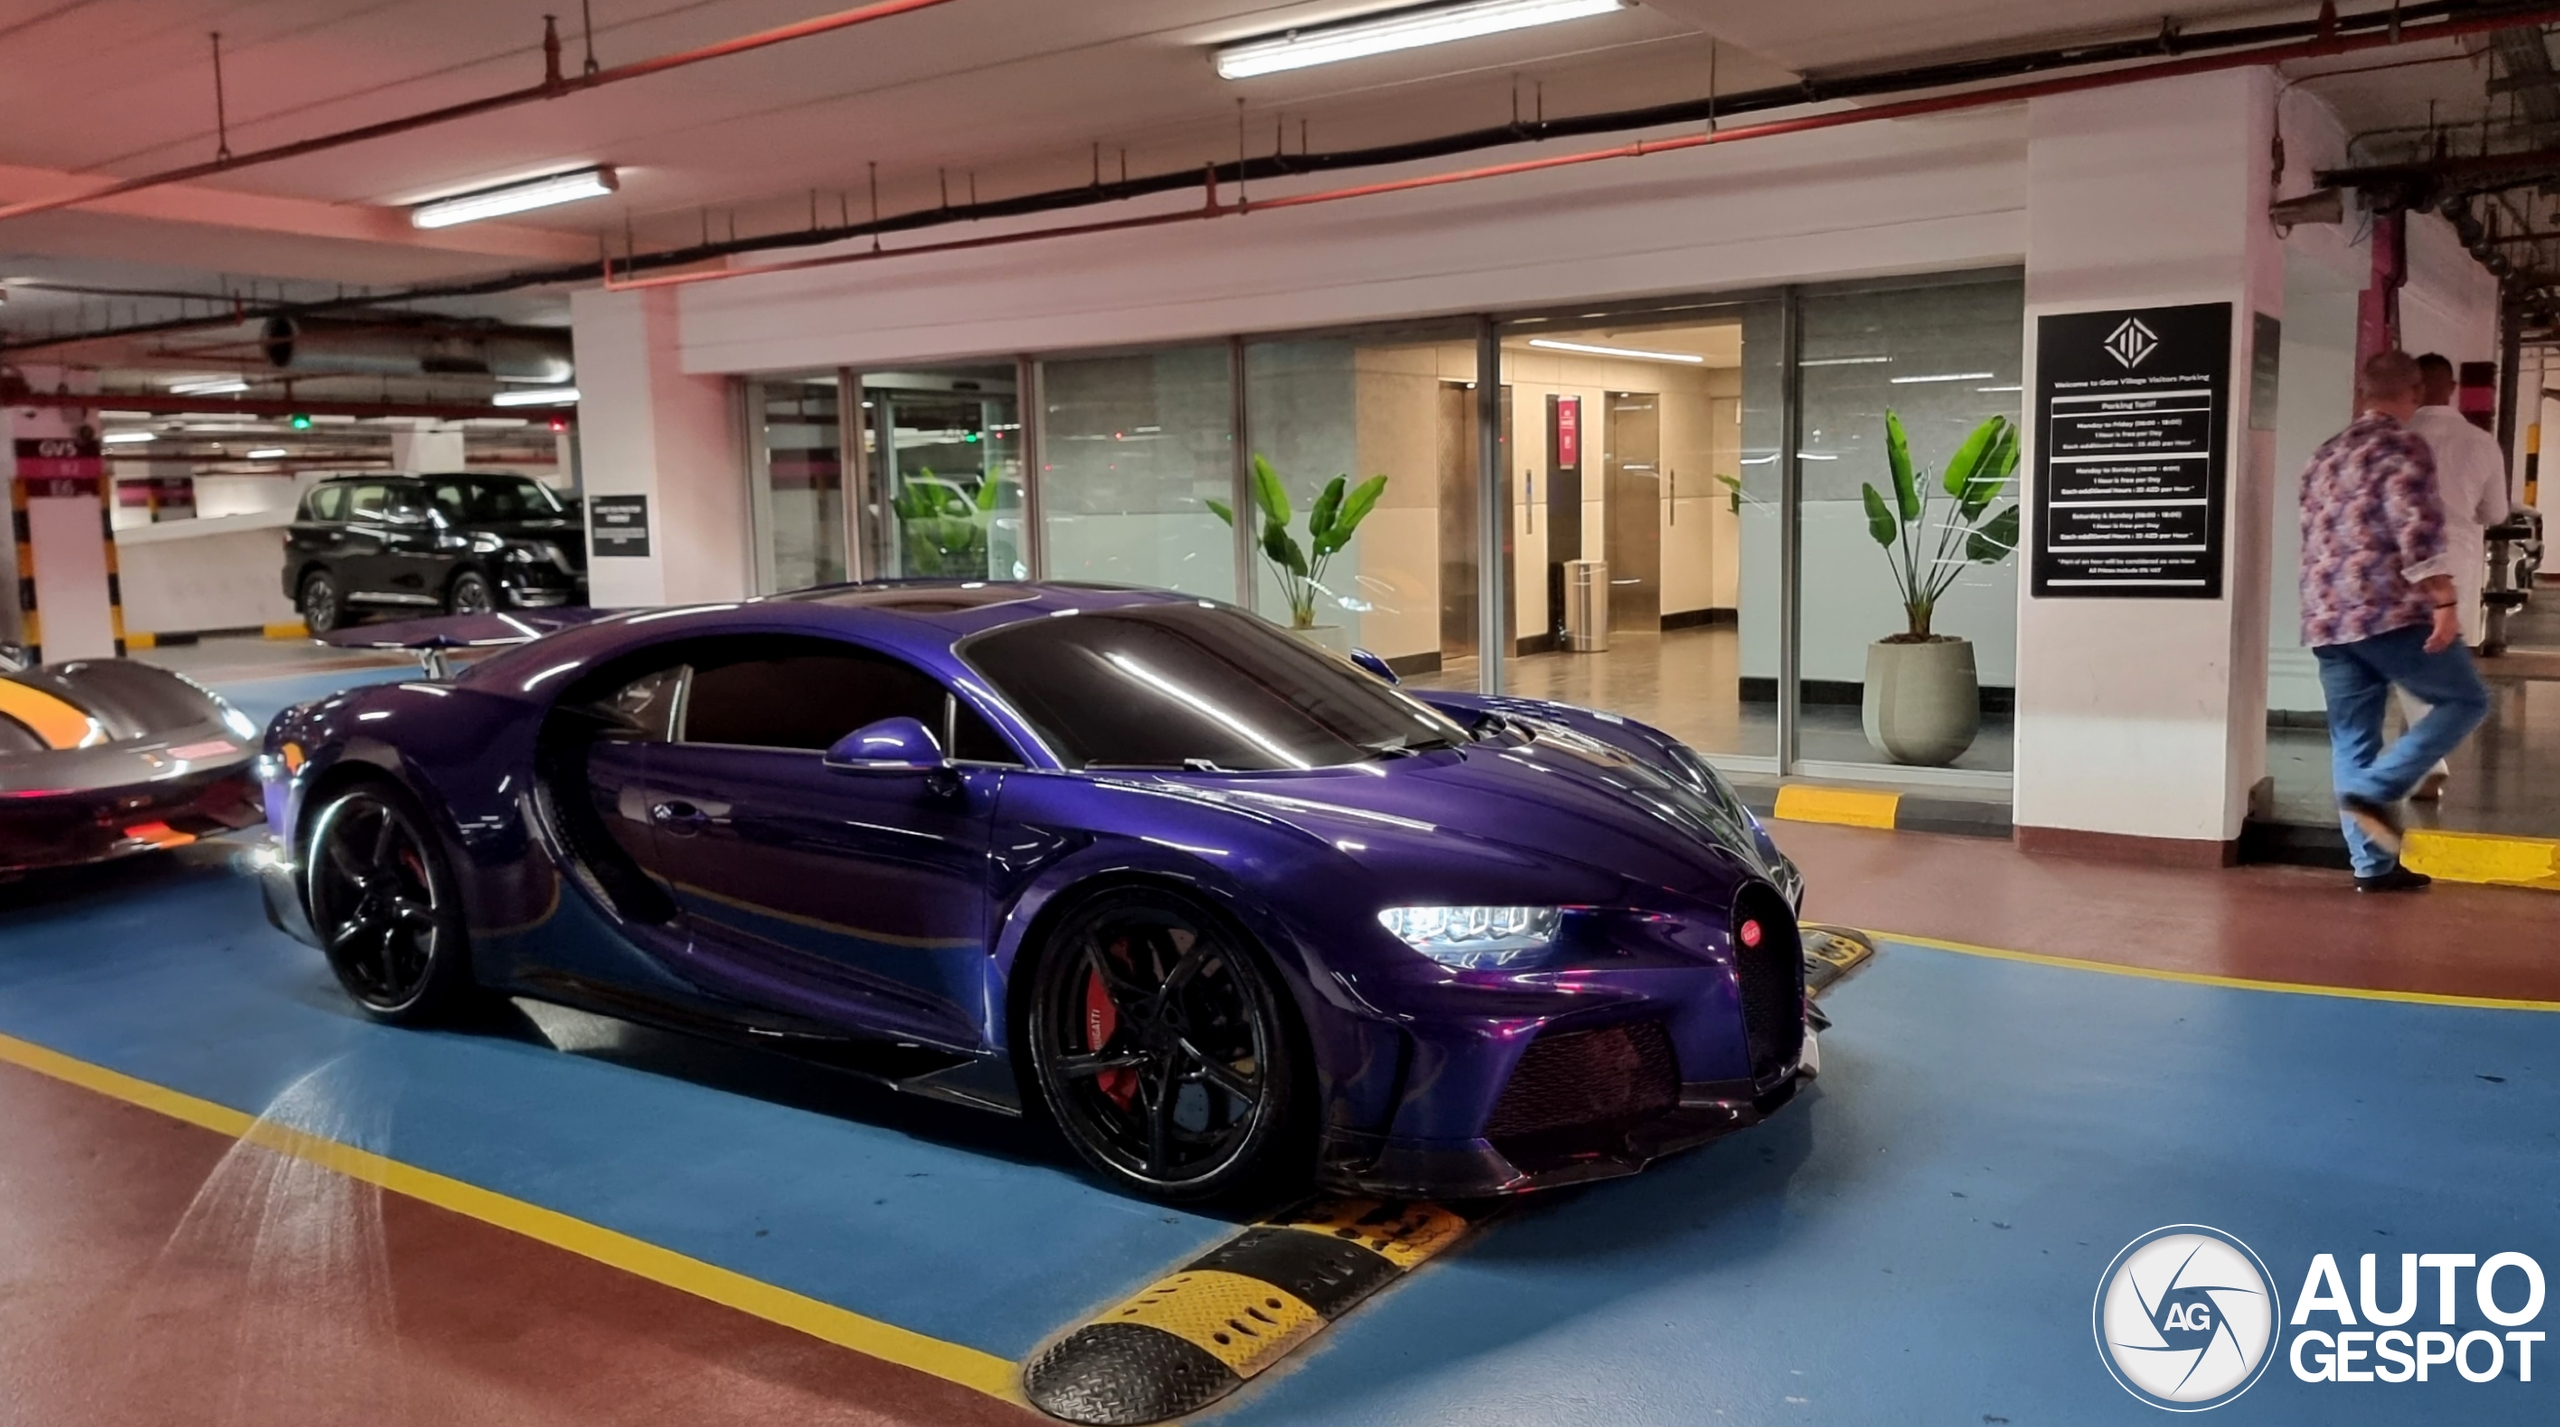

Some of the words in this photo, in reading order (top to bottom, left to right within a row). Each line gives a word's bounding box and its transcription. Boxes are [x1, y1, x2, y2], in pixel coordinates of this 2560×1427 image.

[2120, 378, 2147, 386] Village
[2179, 374, 2210, 382] Parking
[2102, 402, 2133, 410] Parking
[2135, 400, 2156, 408] Tariff
[2109, 512, 2133, 520] Sunday
